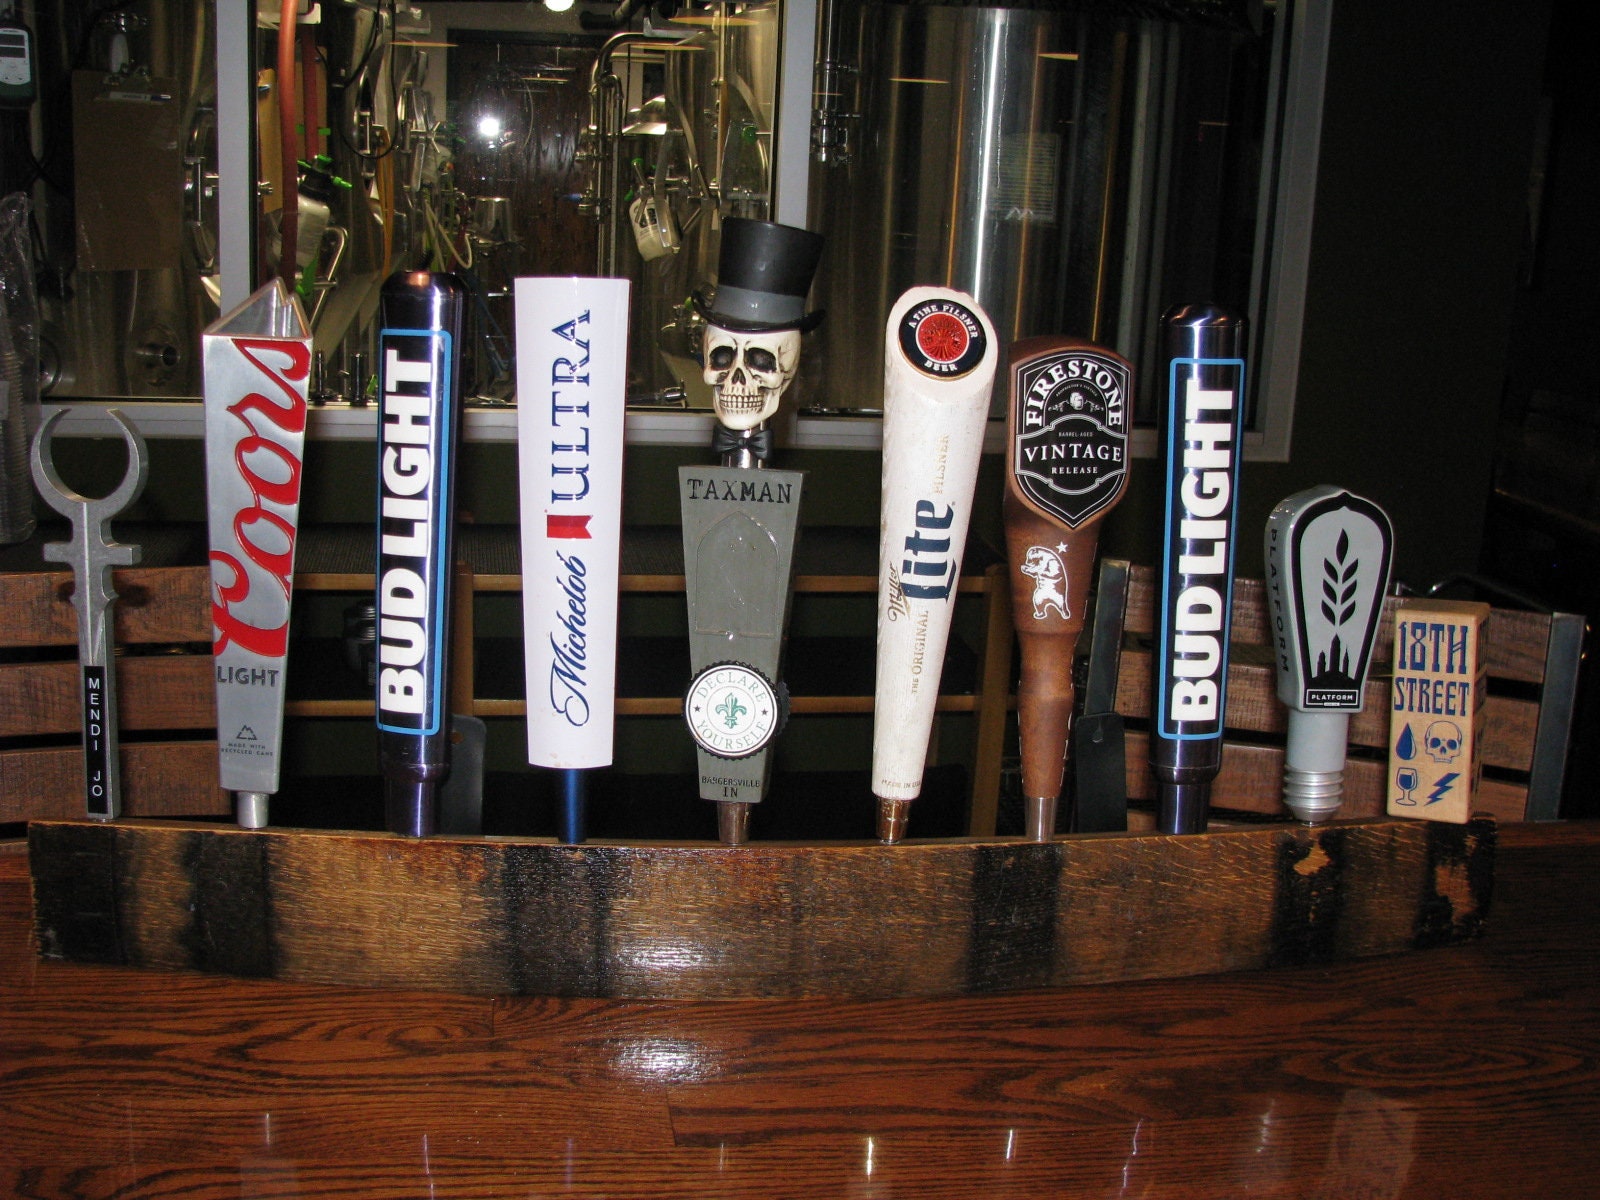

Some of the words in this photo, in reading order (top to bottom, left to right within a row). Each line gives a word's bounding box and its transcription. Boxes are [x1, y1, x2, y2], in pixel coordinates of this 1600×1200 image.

[913, 305, 938, 320] FINE
[942, 304, 978, 338] PILSNER
[924, 360, 958, 371] BEER
[1026, 360, 1122, 427] FIRESTONE
[551, 310, 590, 504] ULTRA
[382, 348, 432, 558] LIGHT
[1024, 443, 1122, 462] VINTAGE
[1051, 466, 1098, 474] RELEASE
[1178, 379, 1234, 575] LIGHT
[209, 338, 311, 657] Coors
[687, 478, 792, 504] TAXMAN
[900, 499, 957, 603] Lite
[888, 561, 908, 622] Miller
[1269, 529, 1290, 673] PLATFORM
[380, 567, 427, 714] BUD
[550, 549, 590, 727] Michelob
[912, 610, 929, 675] ORIGINAL
[1171, 586, 1222, 721] BUD
[1398, 621, 1469, 674] 18TH
[217, 665, 279, 687] LIGHT
[697, 671, 768, 702] DECLARE
[911, 679, 919, 694] THE
[1394, 677, 1470, 716] STREET
[88, 677, 101, 751] MENDI
[697, 719, 768, 750] YOURSELF
[92, 770, 103, 797] JO
[723, 786, 738, 798] IN
